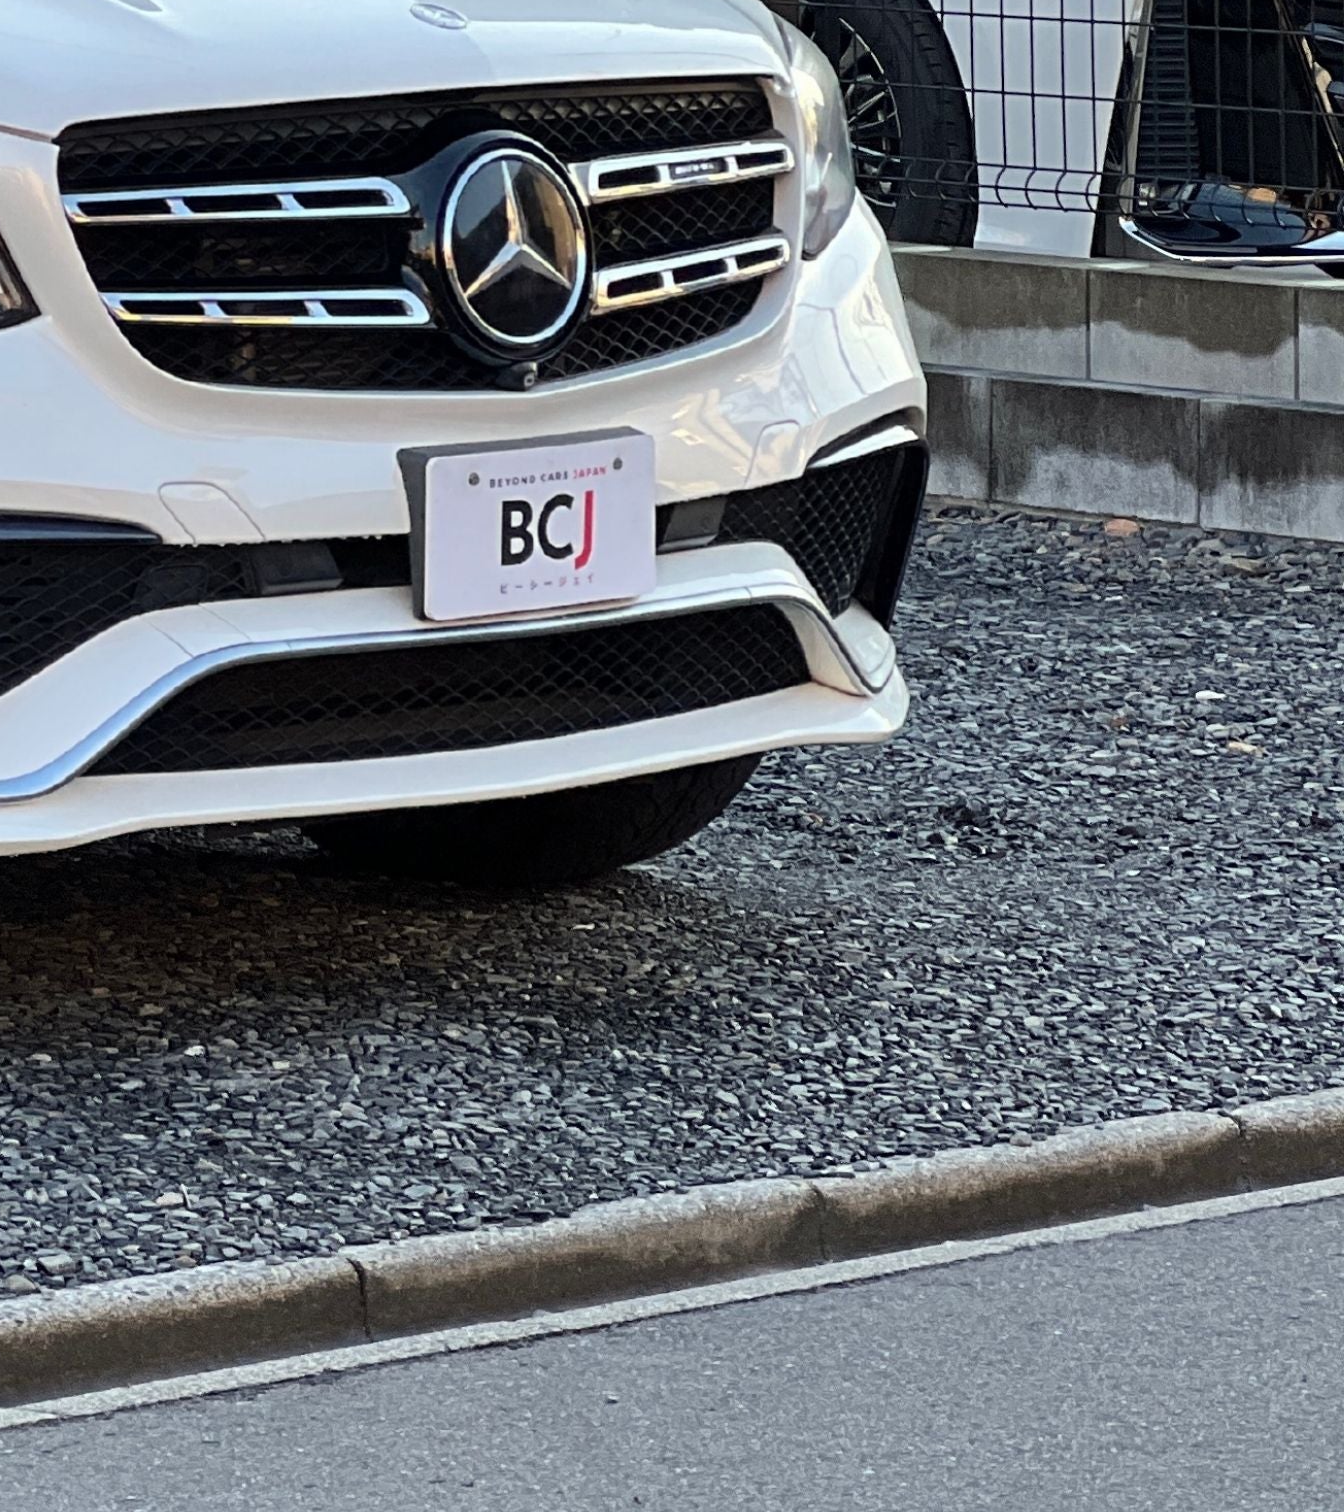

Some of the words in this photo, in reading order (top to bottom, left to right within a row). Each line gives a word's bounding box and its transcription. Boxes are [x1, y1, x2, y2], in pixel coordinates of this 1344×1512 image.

[489, 475, 536, 489] BEYOND
[540, 471, 568, 482] CARS
[573, 466, 607, 479] JAPAN
[500, 489, 594, 571] BCJ
